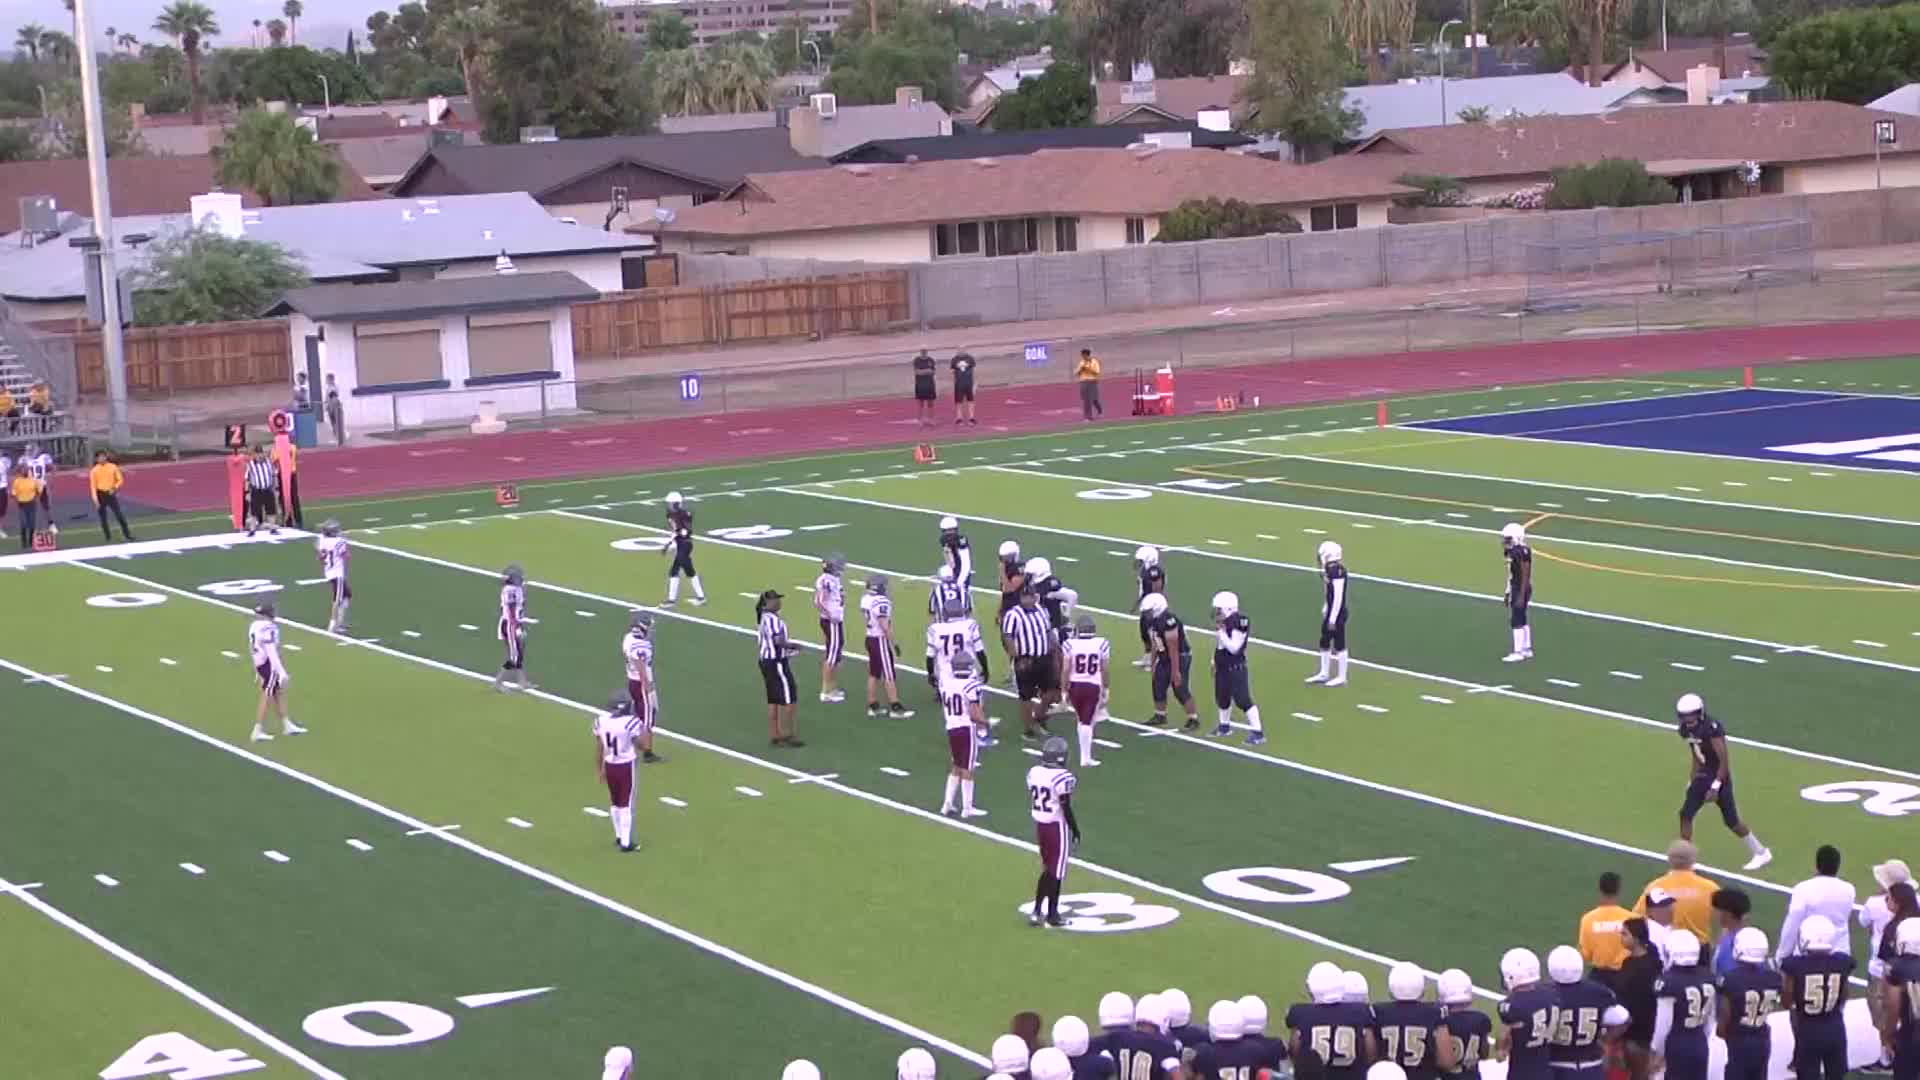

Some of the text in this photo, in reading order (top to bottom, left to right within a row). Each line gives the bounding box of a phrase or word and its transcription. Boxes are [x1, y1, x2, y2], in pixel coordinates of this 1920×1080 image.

[1025, 346, 1047, 360] GOAL
[680, 379, 698, 398] 10
[230, 424, 241, 443] 2
[939, 633, 964, 656] 79
[1075, 653, 1099, 675] 66
[942, 691, 962, 716] 40
[1030, 785, 1053, 813] 22
[1804, 972, 1841, 1015] 51
[1311, 1025, 1357, 1067] 59
[1380, 1025, 1428, 1067] 75
